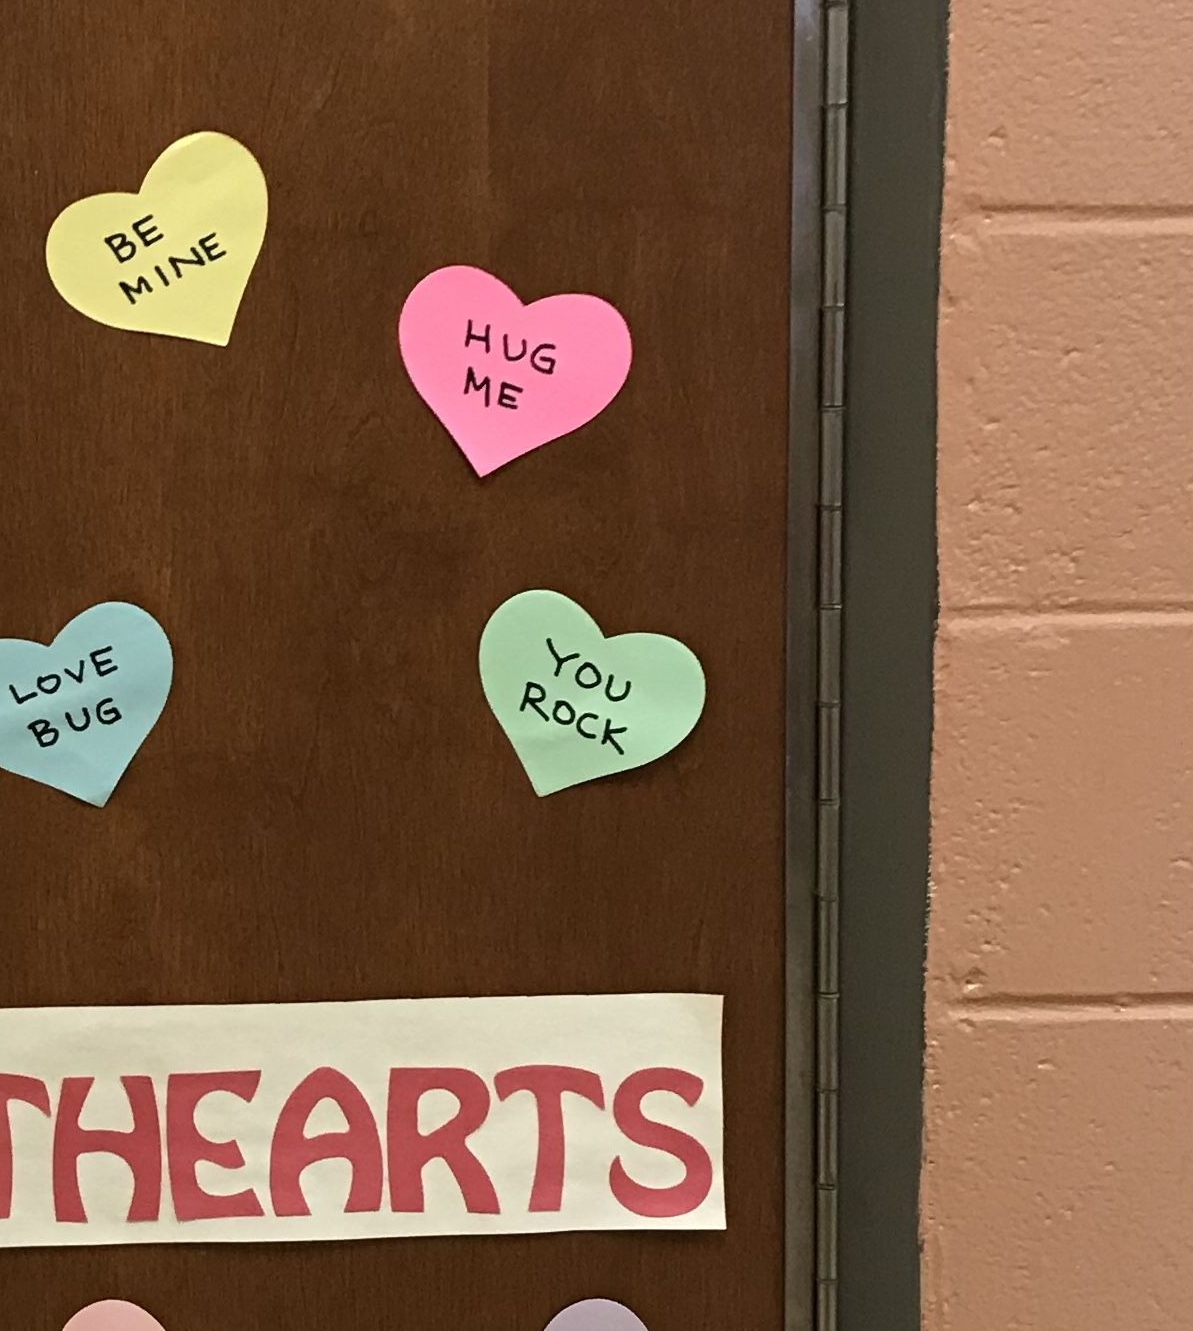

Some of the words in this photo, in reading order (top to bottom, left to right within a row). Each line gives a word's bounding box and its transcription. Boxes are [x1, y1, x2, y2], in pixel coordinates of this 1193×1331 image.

[103, 213, 165, 264] BE
[118, 231, 228, 306] MINE
[464, 318, 557, 376] HUG
[463, 365, 524, 410] ME
[8, 645, 119, 705] LOVE
[545, 637, 632, 703] YOU
[26, 697, 123, 748] BUG
[519, 681, 628, 756] ROCK
